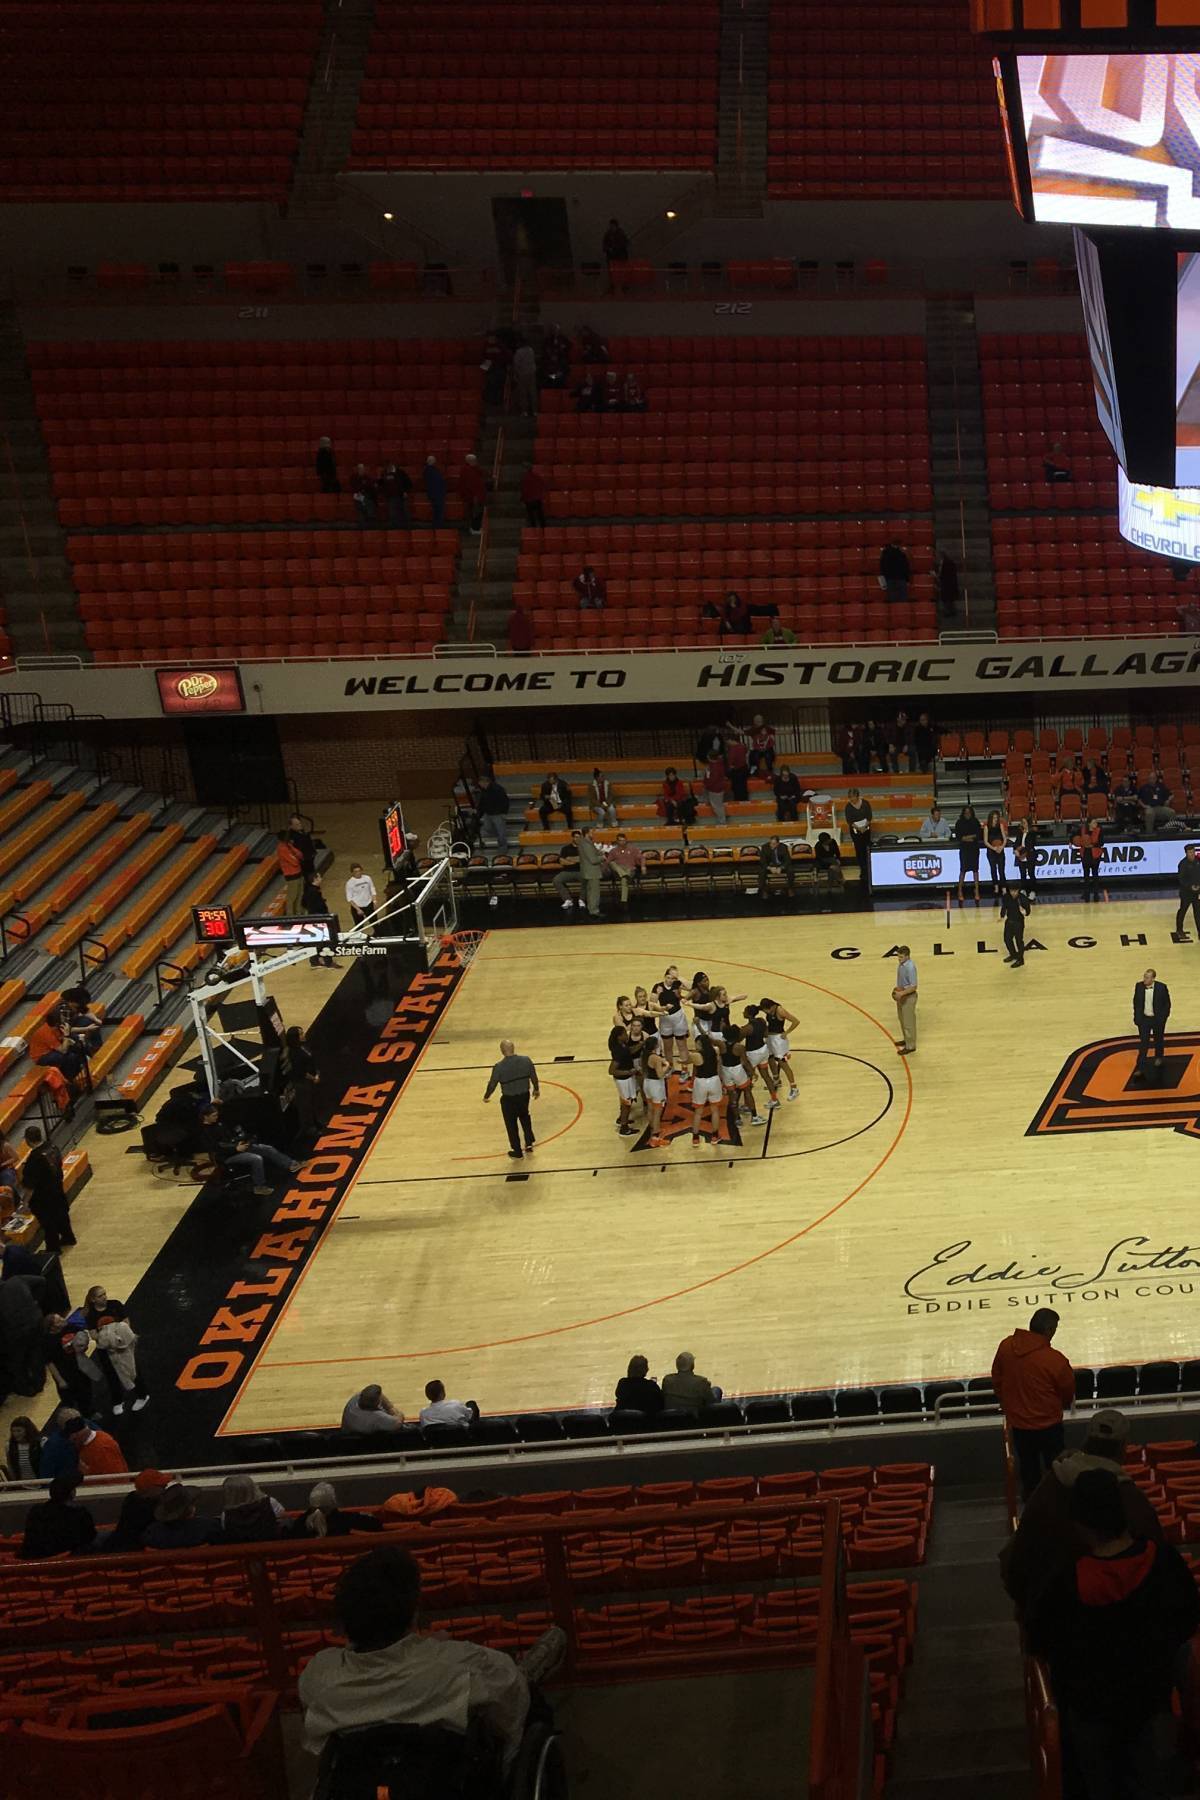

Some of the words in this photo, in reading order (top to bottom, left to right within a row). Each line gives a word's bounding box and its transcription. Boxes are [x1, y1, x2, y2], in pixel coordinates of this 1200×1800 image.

[714, 302, 753, 315] 212
[190, 676, 204, 686] Dr
[344, 672, 554, 696] WELCOME
[570, 669, 626, 690] TO
[697, 658, 956, 688] HISTORIC
[182, 679, 215, 697] Pepper
[905, 859, 941, 870] BEDLAM
[1014, 846, 1145, 867] OMEAND
[175, 1080, 396, 1391] OKLAHOMA
[367, 950, 463, 1065] STATE
[904, 1240, 1061, 1301] Eddie
[907, 1299, 992, 1315] EDDIE
[1008, 1289, 1119, 1307] SUTTON
